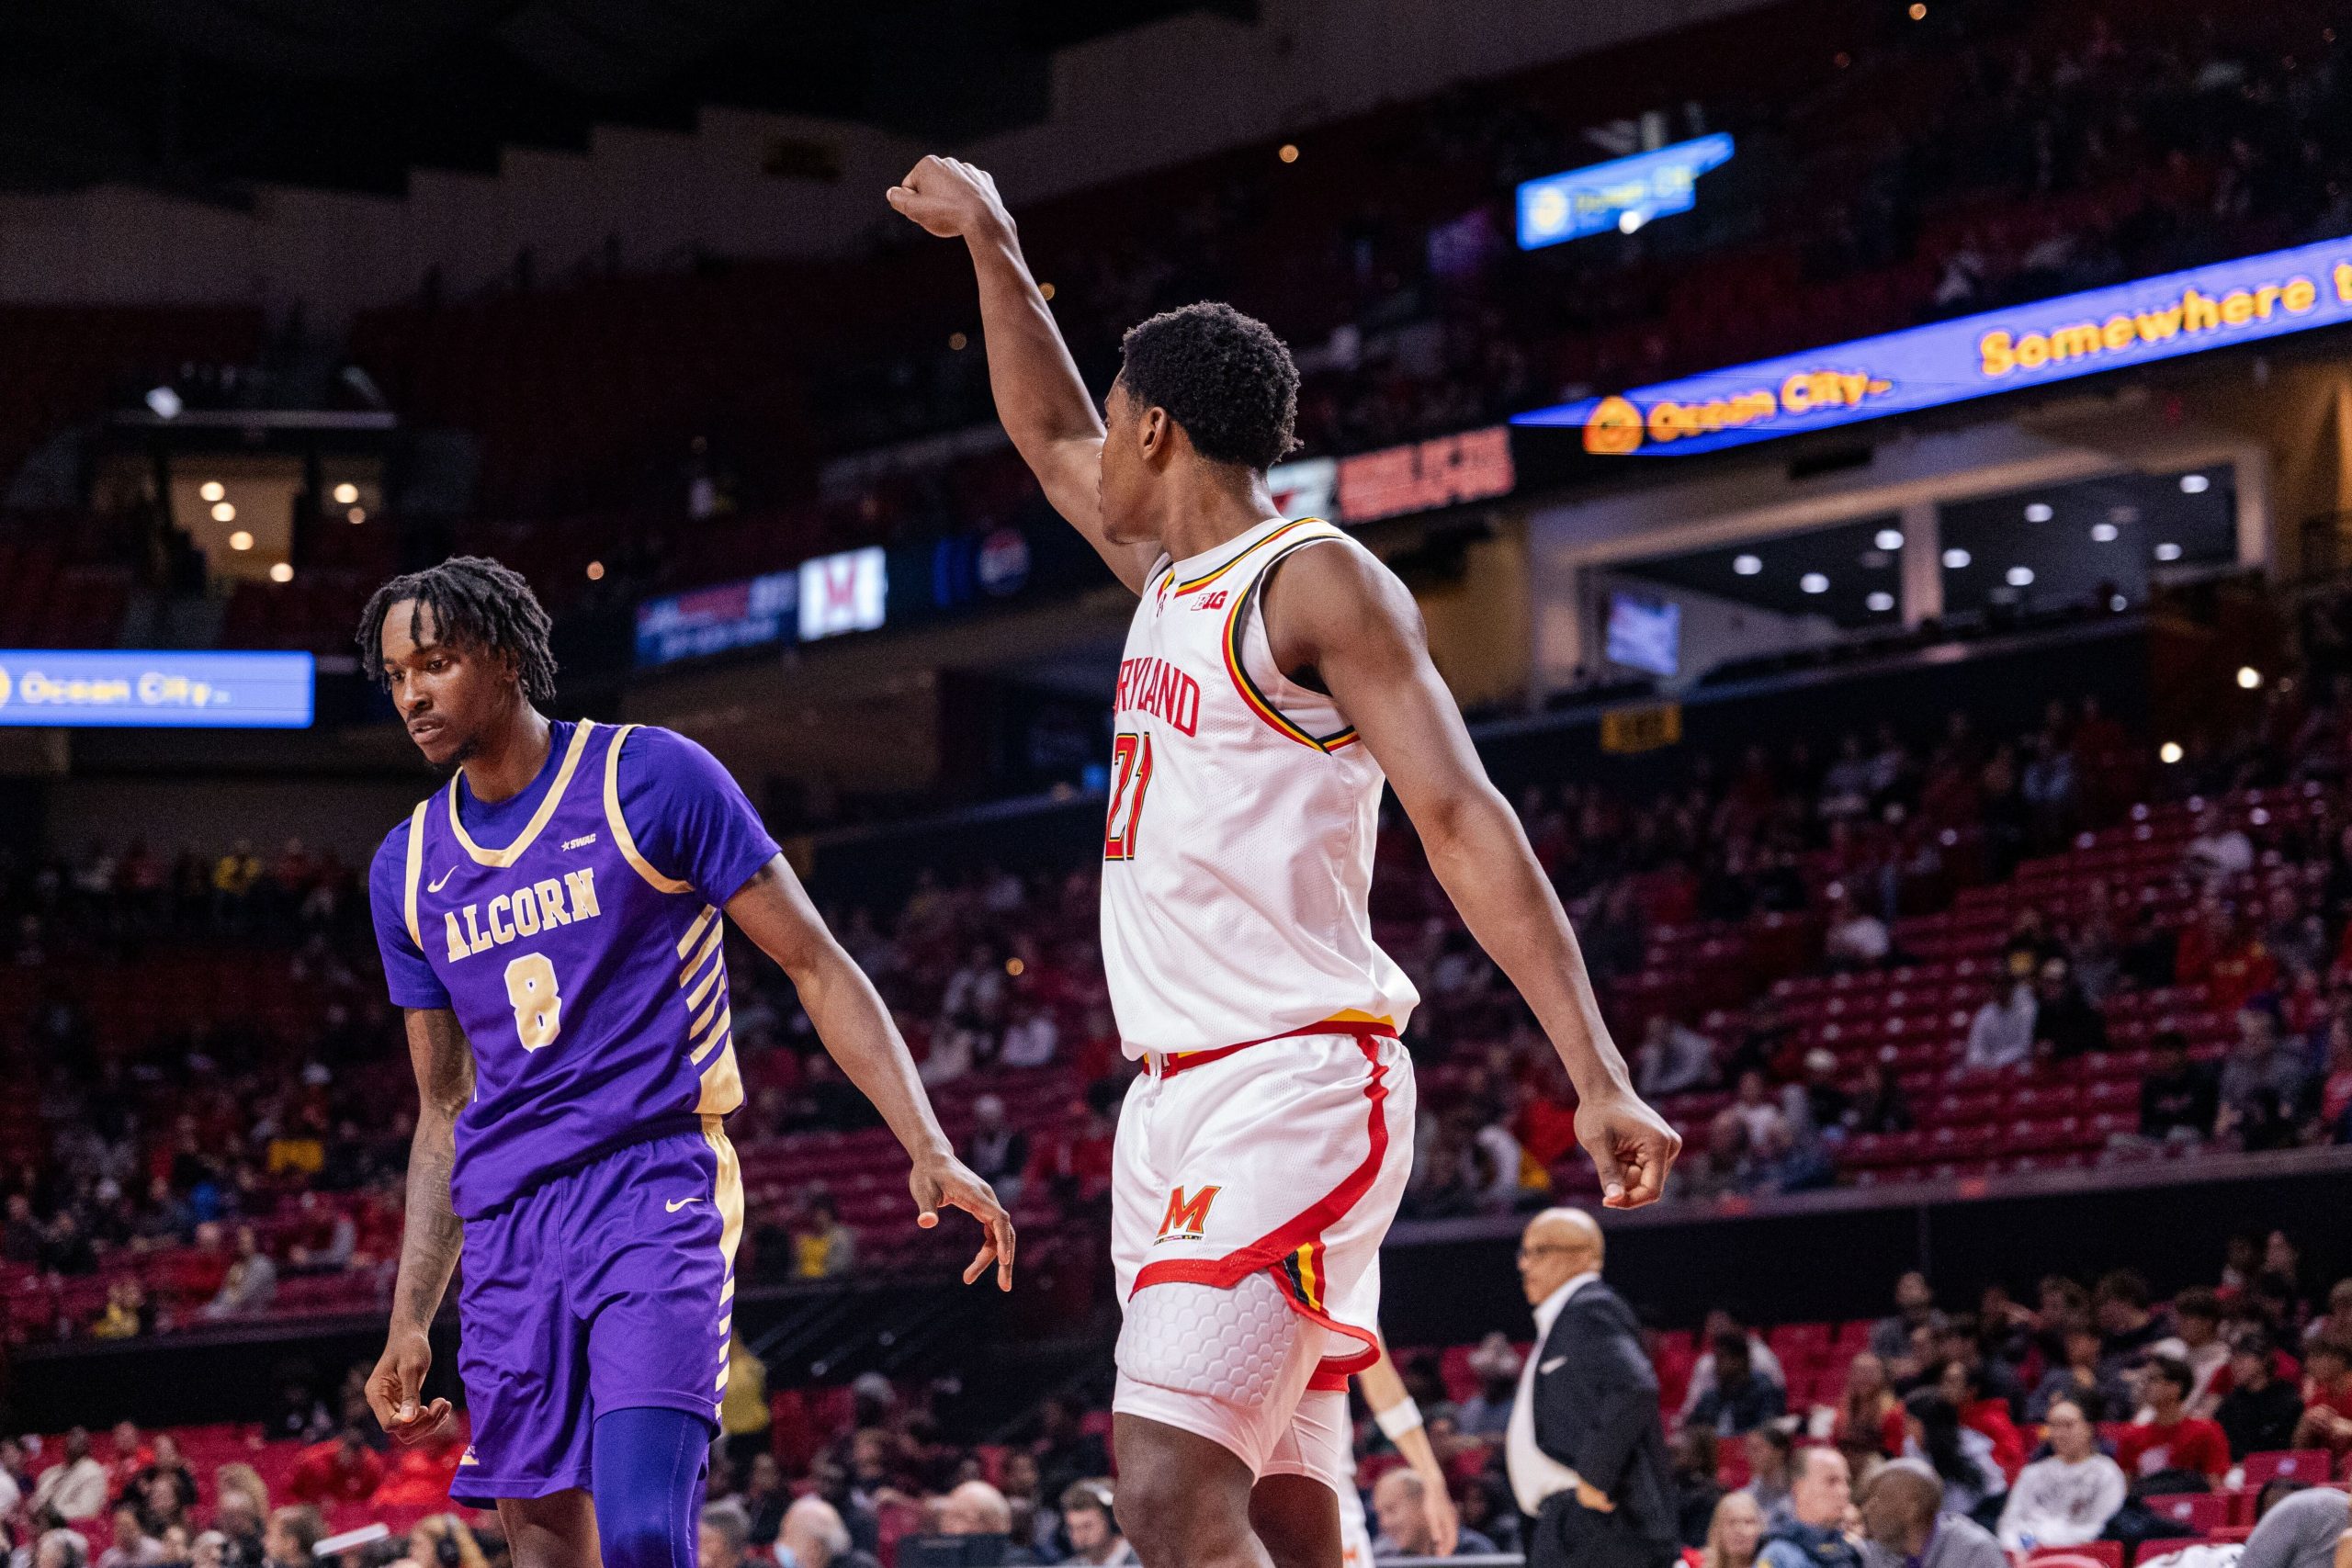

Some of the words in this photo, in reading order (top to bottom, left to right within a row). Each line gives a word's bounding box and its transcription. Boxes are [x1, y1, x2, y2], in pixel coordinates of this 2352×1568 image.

[1980, 279, 2315, 377] Somewhere
[1113, 656, 1201, 739] RYLAND
[570, 832, 596, 850] SWAC
[1104, 731, 1154, 862] 21
[444, 867, 602, 964] ALCORN
[503, 952, 562, 1054] 8
[1157, 1185, 1222, 1238] M
